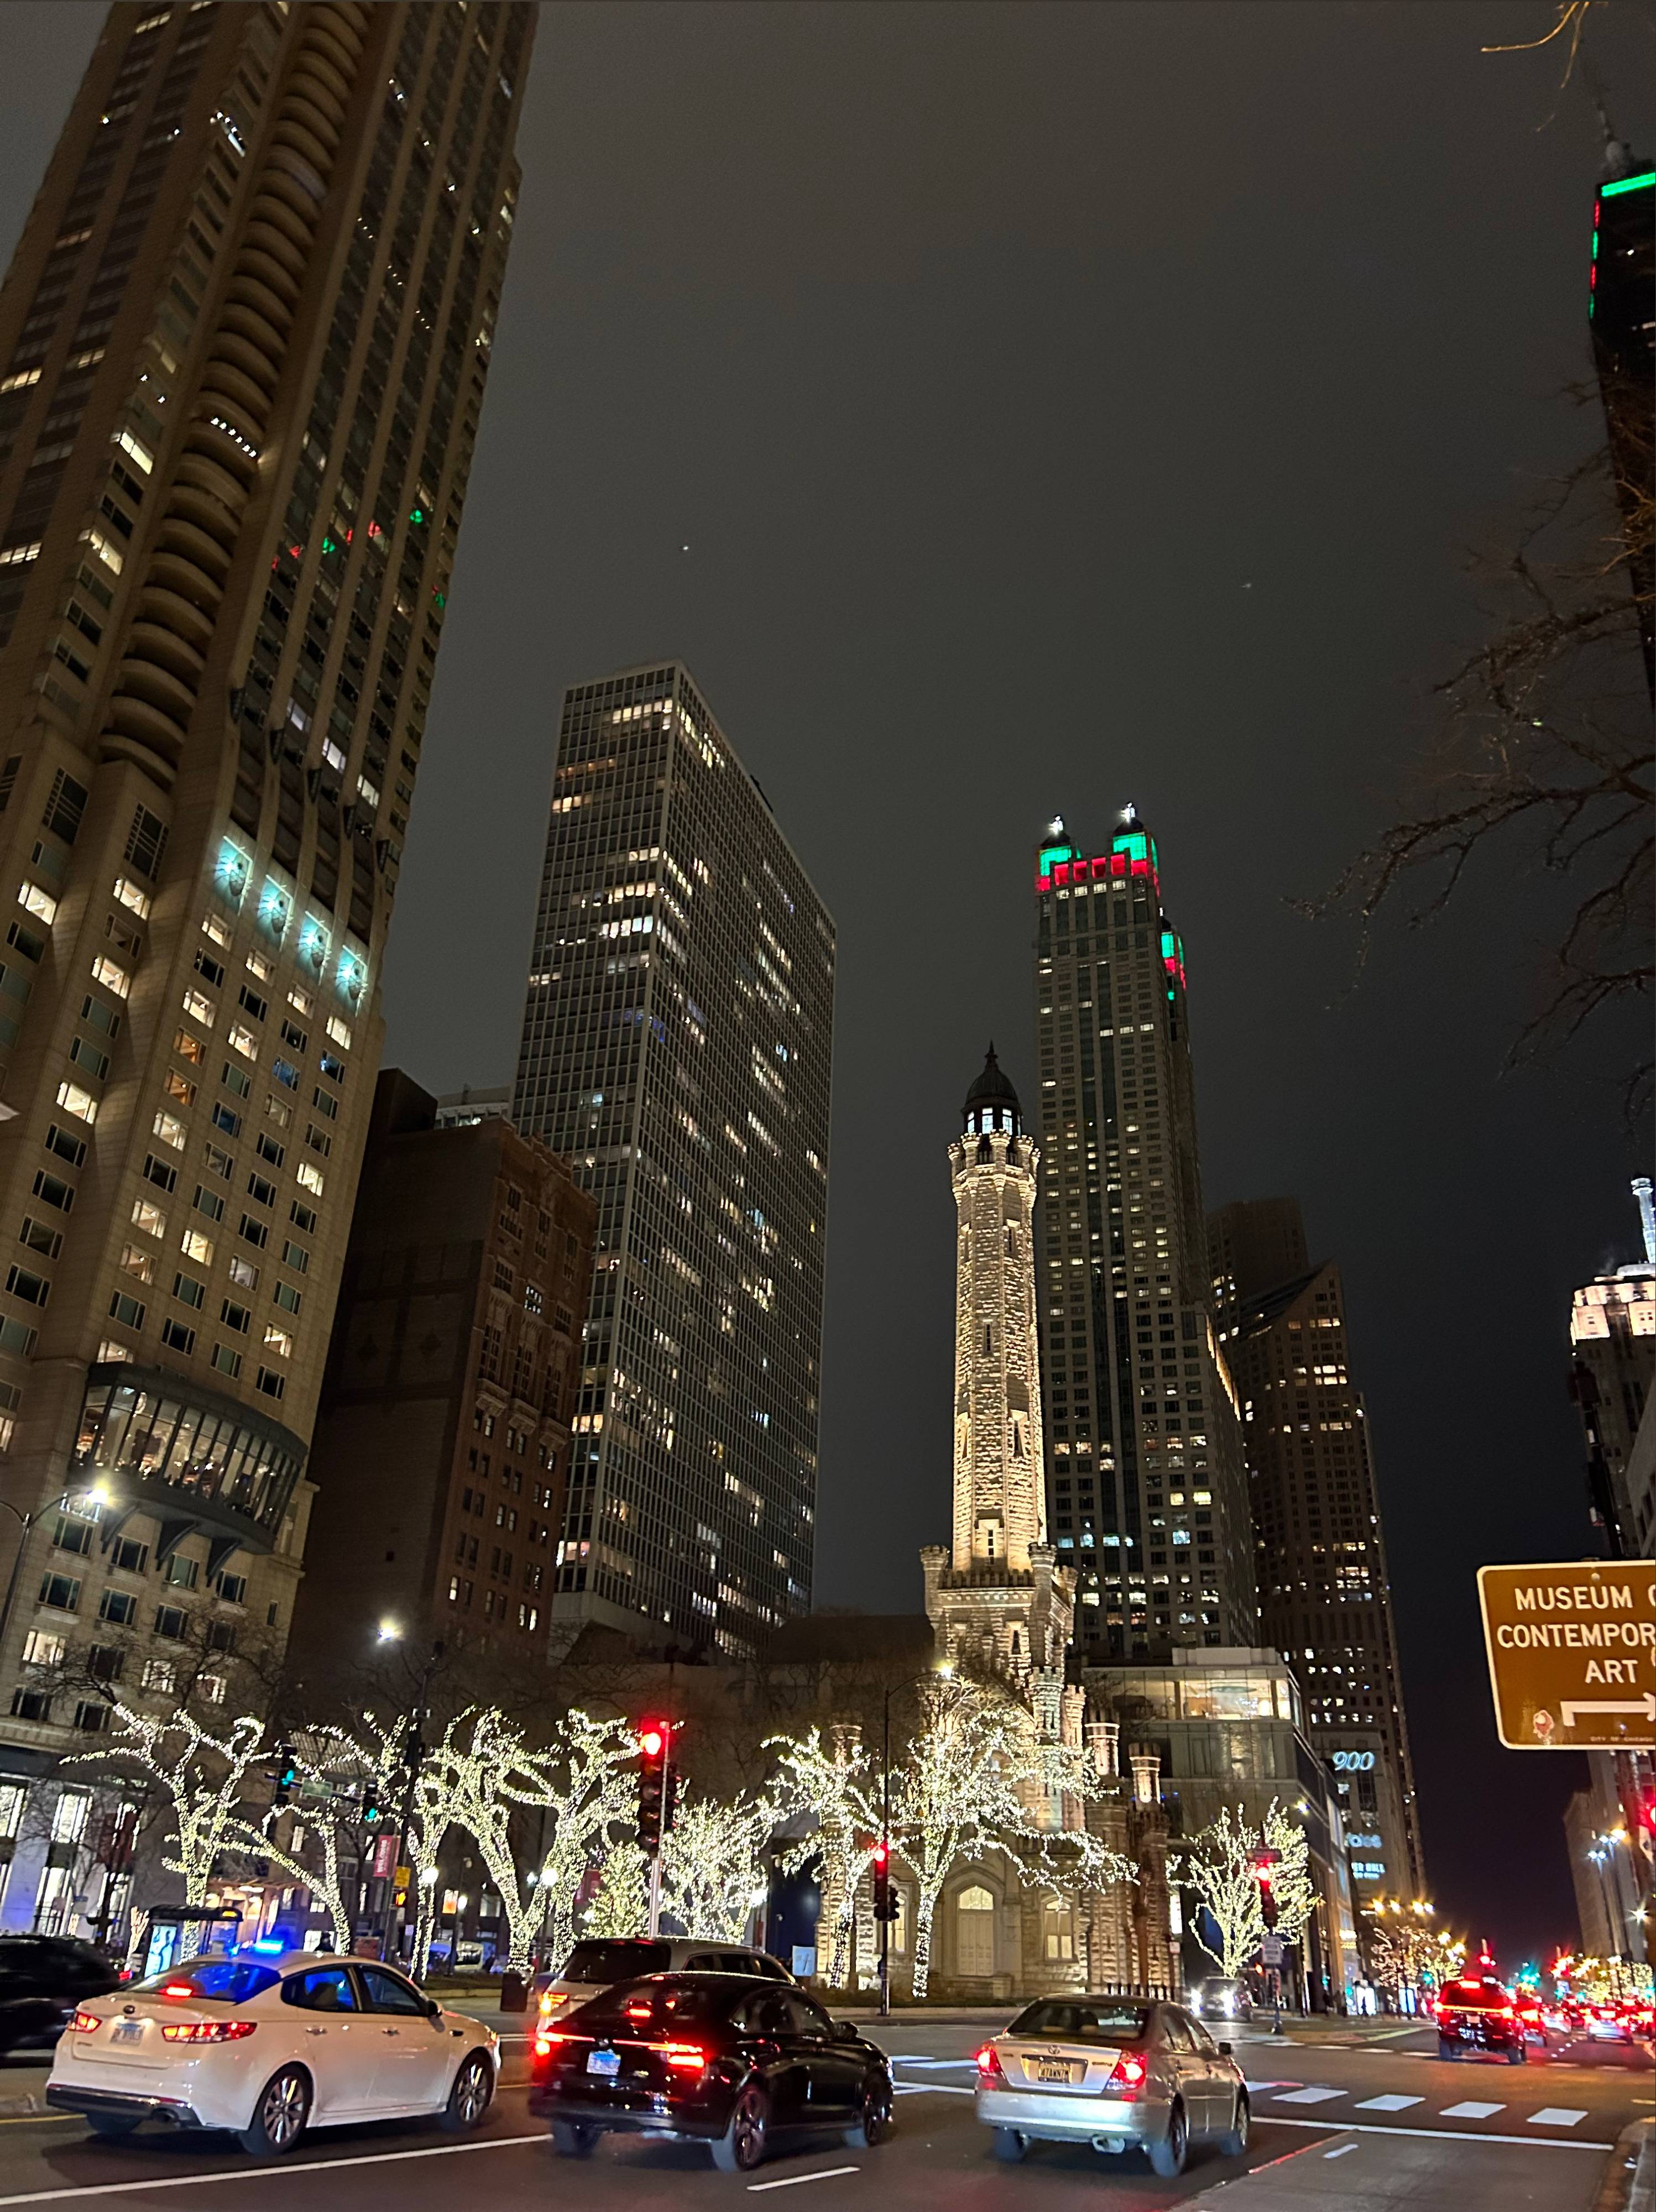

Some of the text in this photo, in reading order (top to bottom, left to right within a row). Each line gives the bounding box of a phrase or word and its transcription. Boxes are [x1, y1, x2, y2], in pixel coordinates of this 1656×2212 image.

[1515, 1586, 1633, 1610] MUSEUM
[1585, 1660, 1638, 1683] ART
[1333, 1751, 1375, 1771] 900
